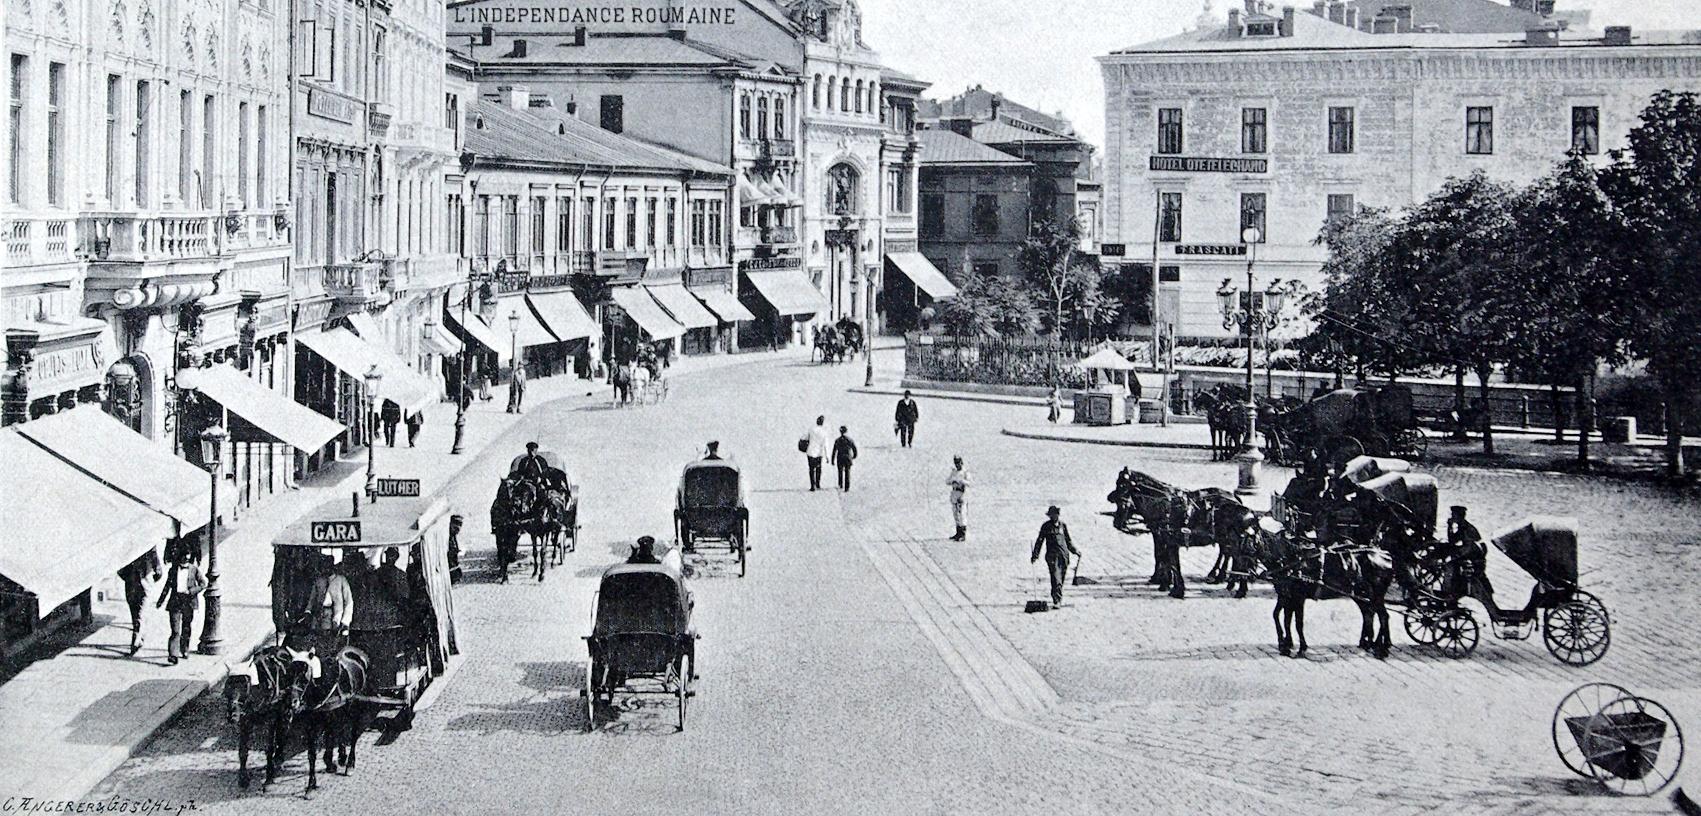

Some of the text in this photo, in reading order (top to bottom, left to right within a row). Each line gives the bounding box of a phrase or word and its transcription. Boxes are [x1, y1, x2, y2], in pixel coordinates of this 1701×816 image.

[632, 7, 735, 24] ROUMAINE
[1152, 157, 1184, 169] HOTEL
[378, 481, 419, 495] LUTHER
[314, 525, 358, 541] GARA
